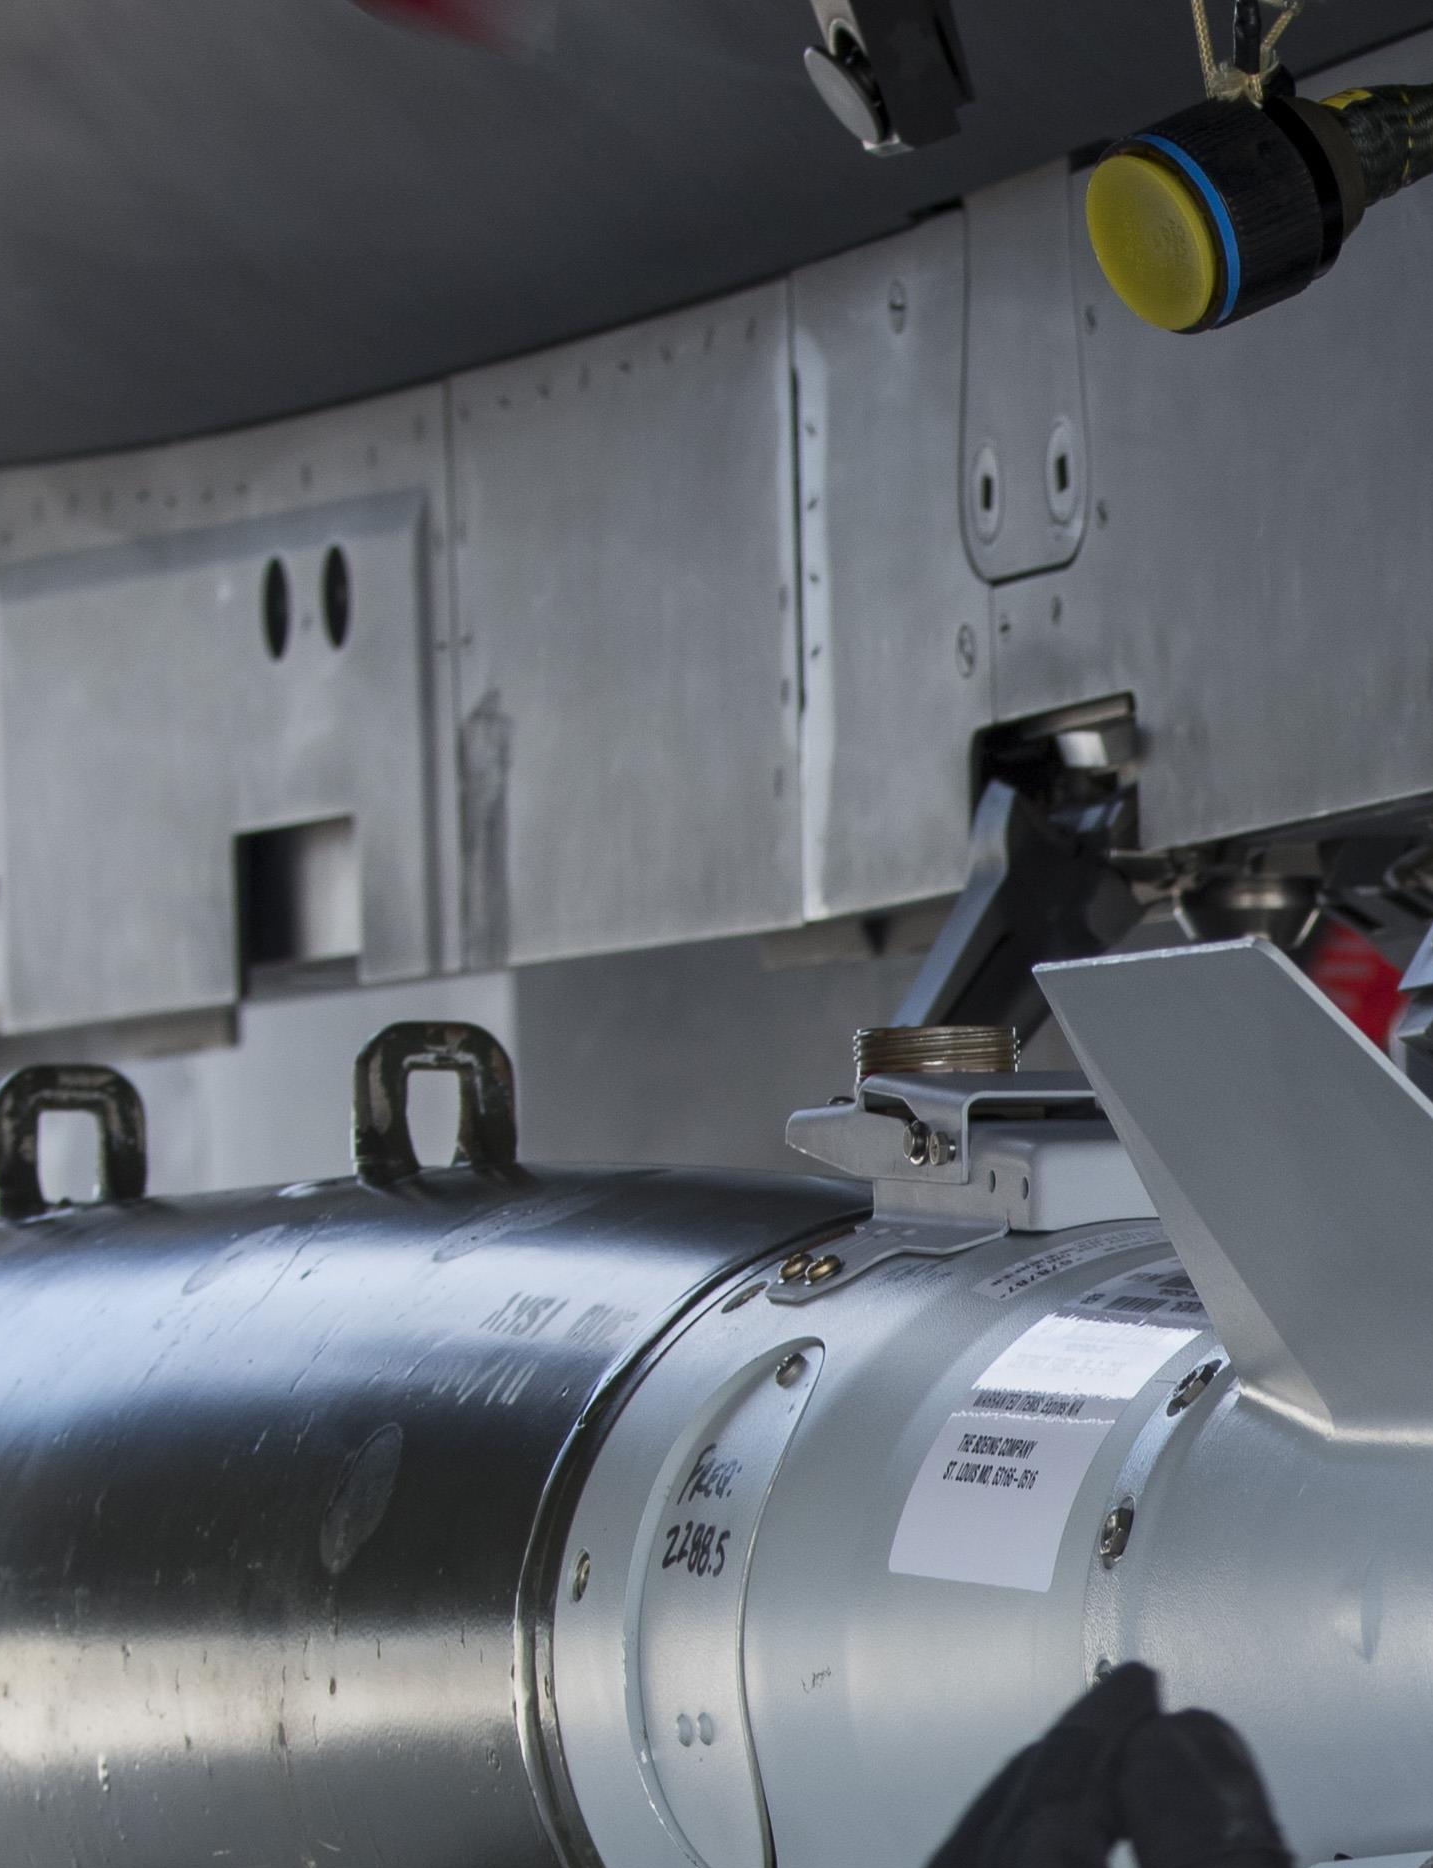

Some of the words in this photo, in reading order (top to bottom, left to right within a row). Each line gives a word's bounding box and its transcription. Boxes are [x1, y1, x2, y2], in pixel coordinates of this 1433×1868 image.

[958, 1433, 977, 1452] THE
[971, 1435, 1003, 1455] BOEING
[998, 1438, 1038, 1459] COMPANY
[955, 1462, 981, 1483] LOUIS
[661, 1519, 731, 1578] 2288.5
